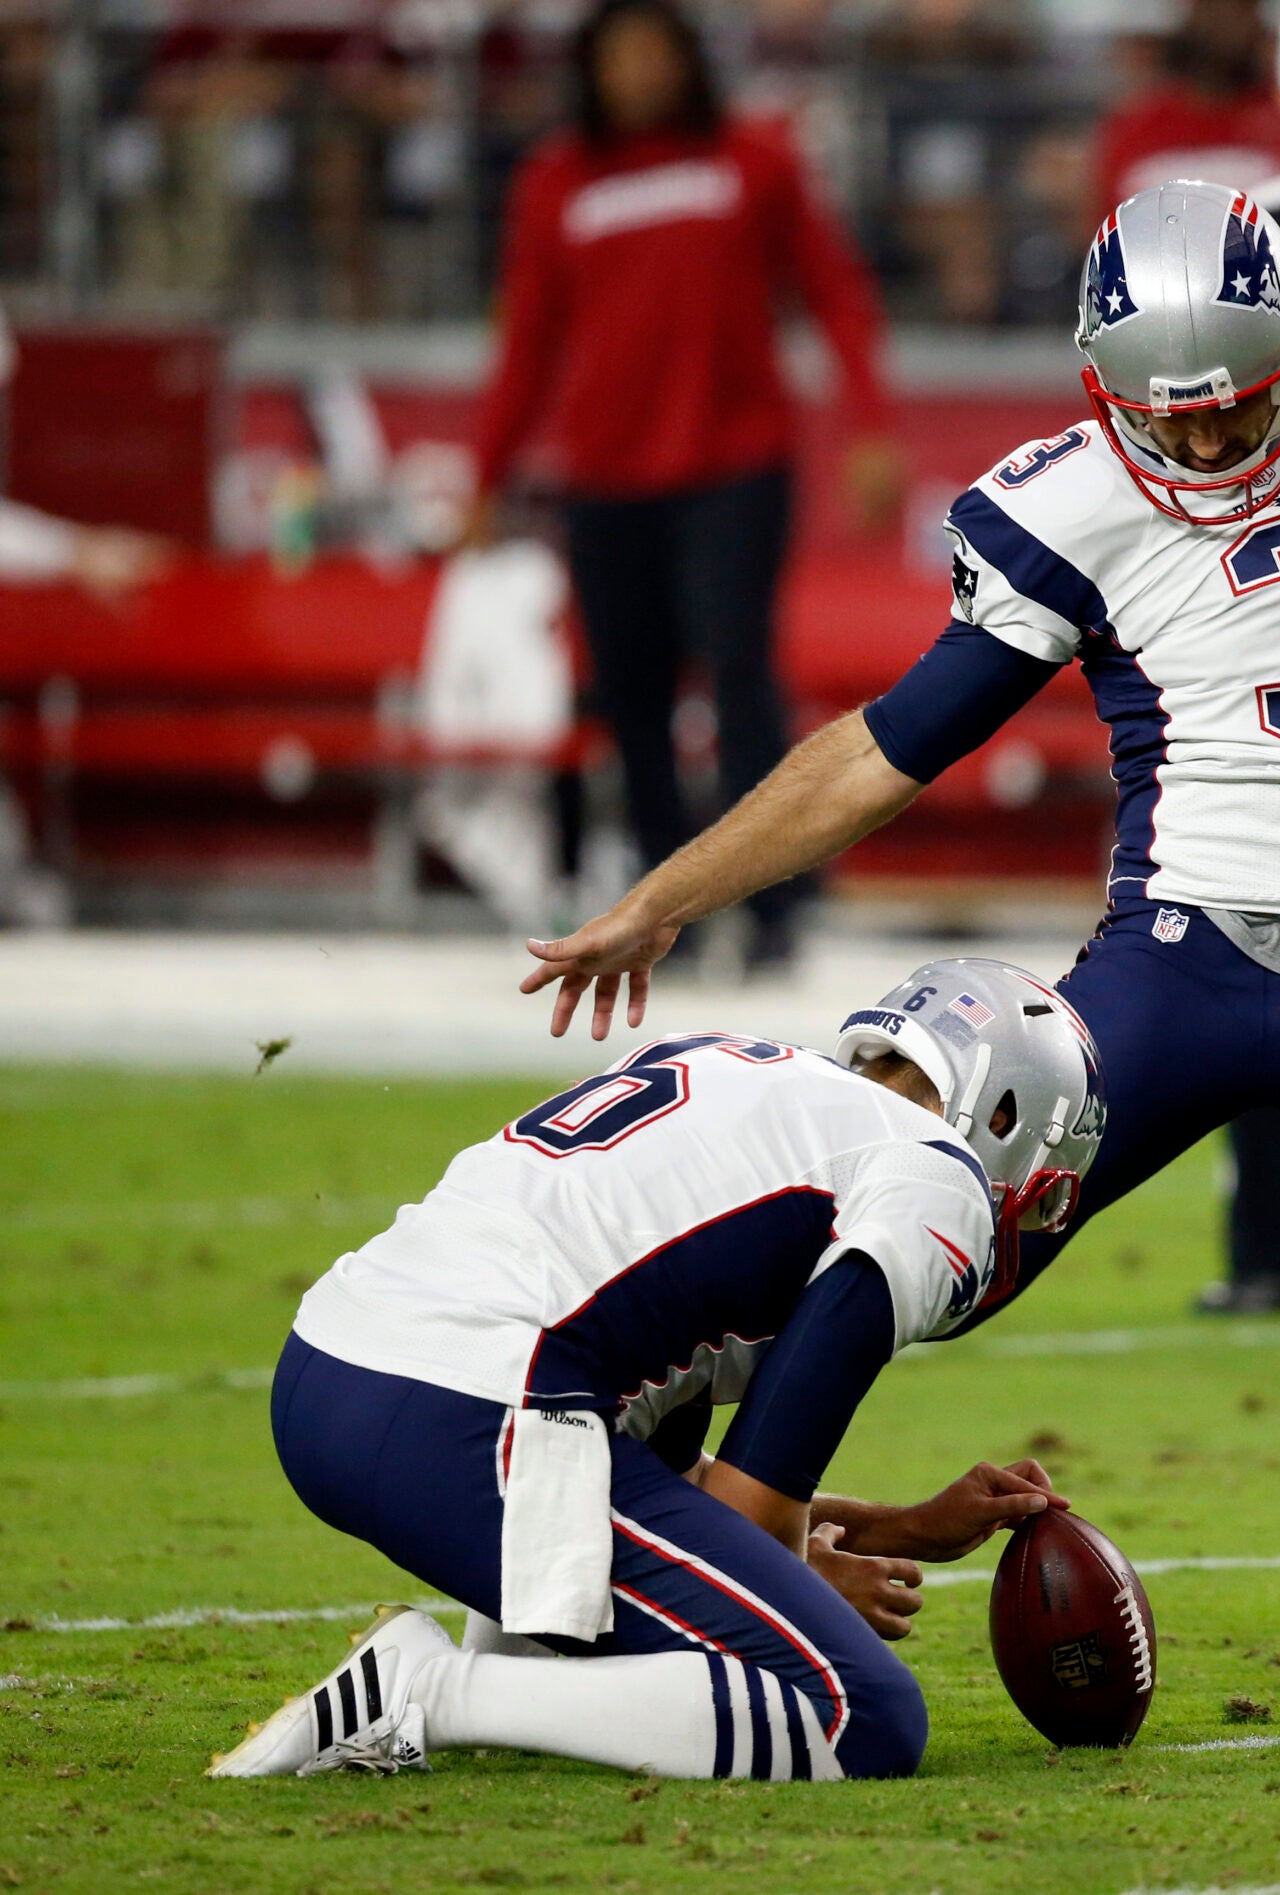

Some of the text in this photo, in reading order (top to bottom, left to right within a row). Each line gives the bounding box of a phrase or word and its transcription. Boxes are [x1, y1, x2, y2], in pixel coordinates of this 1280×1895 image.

[992, 428, 1092, 490] 3
[1157, 922, 1179, 939] NFL
[902, 986, 938, 1012] 6
[503, 1032, 794, 1160] 6
[1053, 1645, 1091, 1688] NFL
